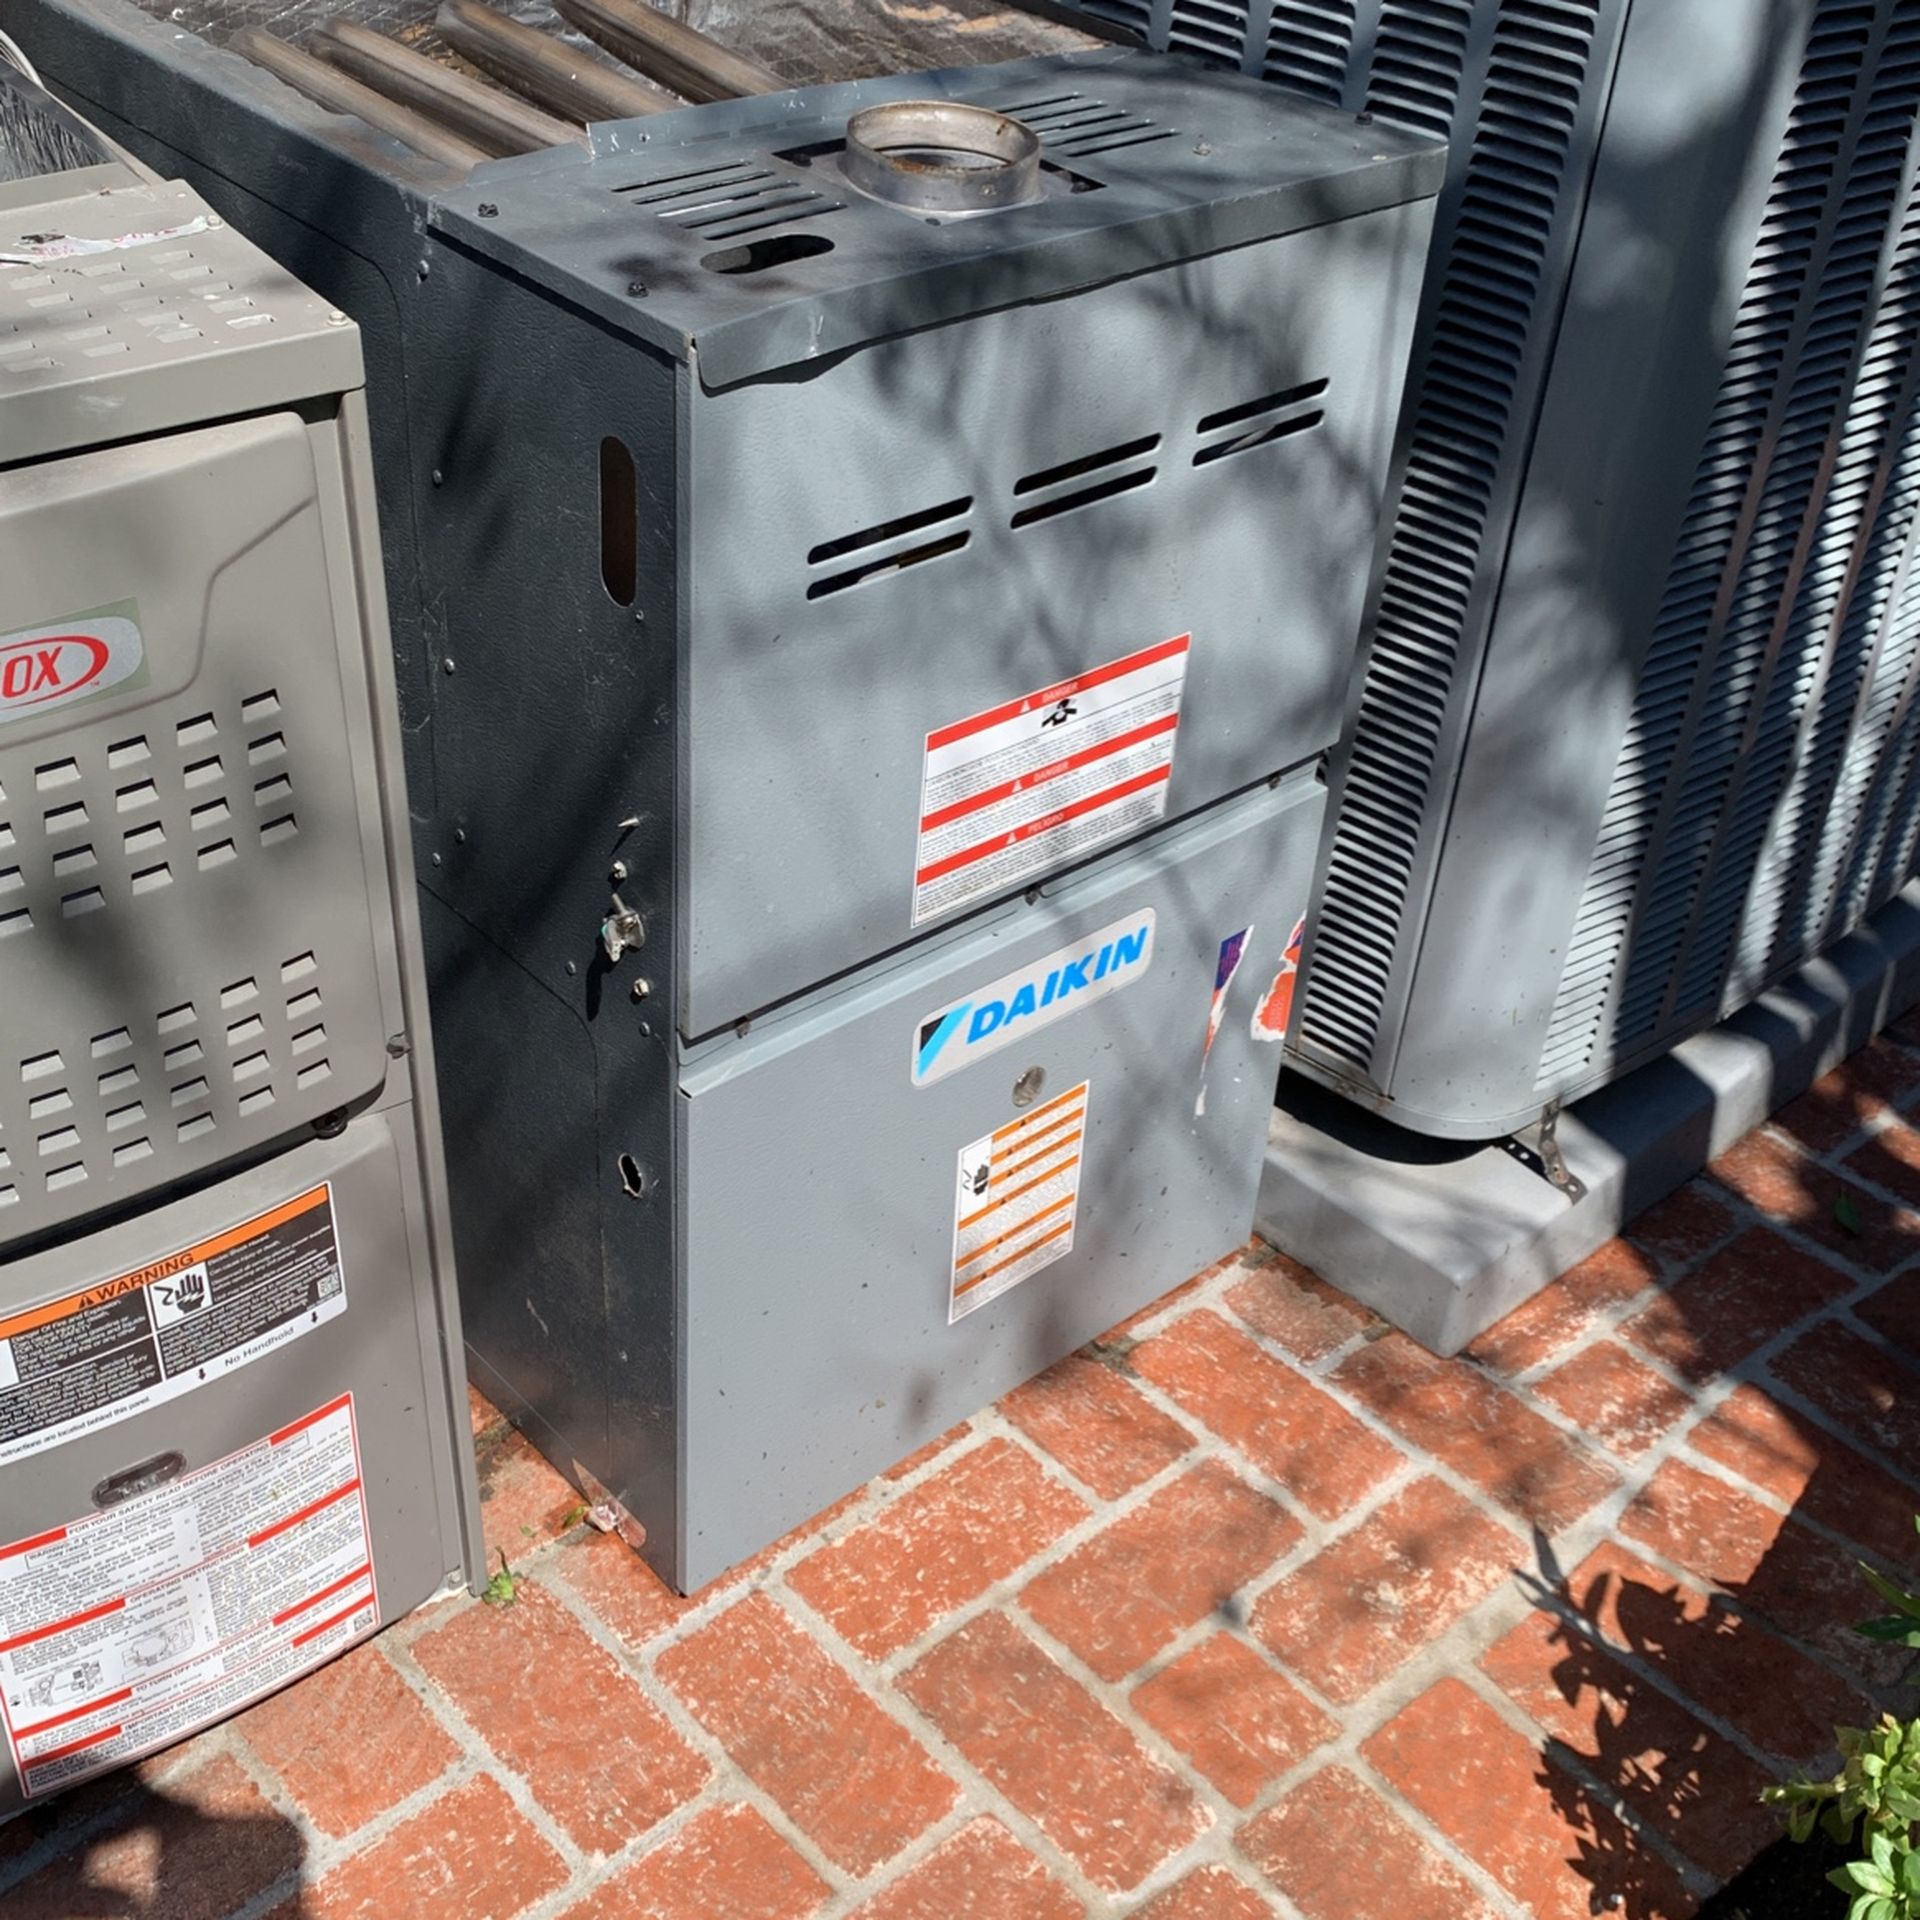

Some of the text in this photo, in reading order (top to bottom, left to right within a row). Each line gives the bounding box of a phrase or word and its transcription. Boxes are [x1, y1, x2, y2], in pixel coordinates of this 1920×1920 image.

[1, 646, 63, 699] OX
[966, 926, 1148, 1045] DAIKIN
[97, 1253, 194, 1302] WARNING
[223, 1326, 294, 1366] No Handhold
